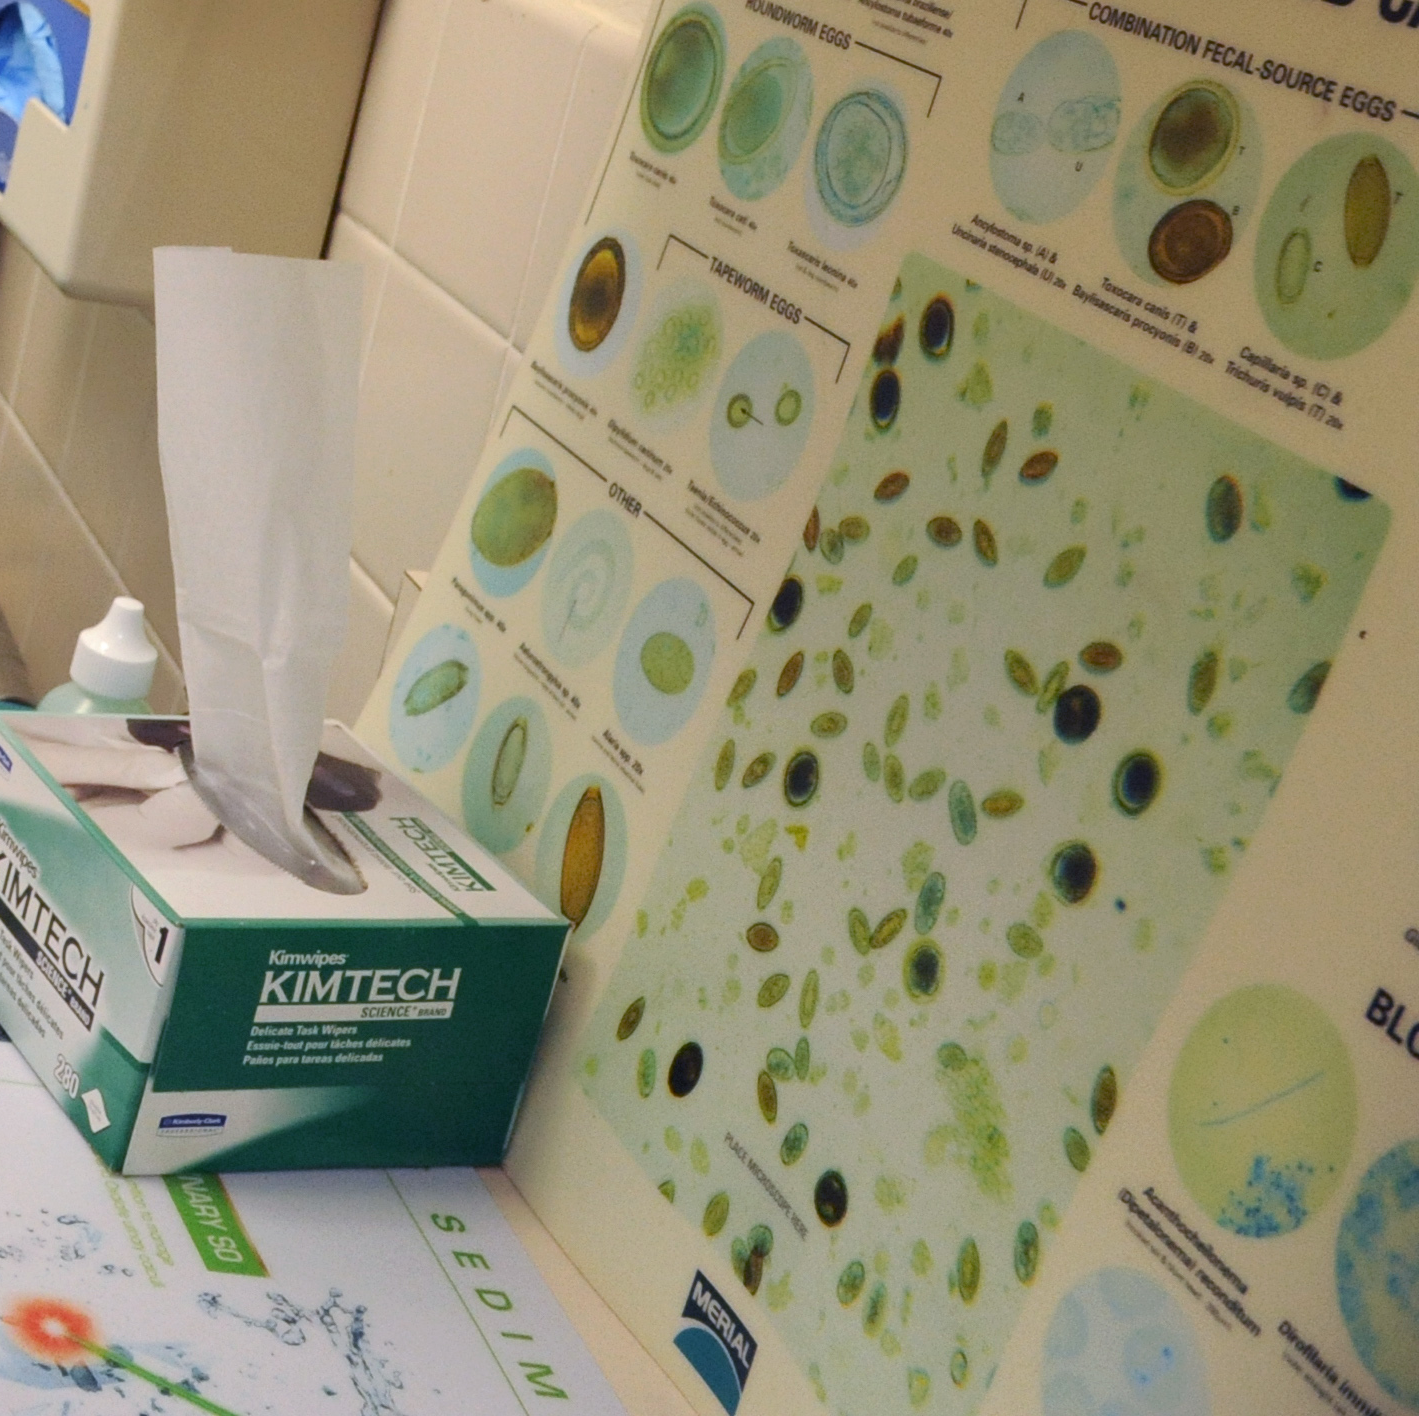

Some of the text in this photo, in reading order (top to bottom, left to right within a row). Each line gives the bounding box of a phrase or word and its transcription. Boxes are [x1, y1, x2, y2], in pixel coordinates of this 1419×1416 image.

[819, 24, 852, 50] EGGS
[1088, 1, 1398, 122] COMBINATION FECAL-SOURCE EGGS
[952, 222, 987, 250] Uncinaria
[988, 244, 1039, 276] stenocephala
[971, 214, 1021, 247] Ancylostoma
[1049, 251, 1058, 264] &
[708, 256, 770, 306] TAPEWORM
[769, 291, 803, 325] EGGS
[1101, 277, 1143, 307] Toxocara
[1144, 301, 1171, 320] canis
[1187, 320, 1198, 334] &
[1131, 317, 1181, 348] procyonis
[1181, 340, 1199, 356] (B)
[1225, 360, 1270, 393] Trichuris
[1273, 388, 1306, 412] vulpis
[1240, 346, 1291, 380] Capillaria
[1330, 391, 1343, 406] &
[608, 482, 643, 518] OTHER
[390, 817, 484, 893] KIMTECH
[13, 947, 35, 980] Wipers
[154, 926, 169, 965] 1
[269, 950, 348, 968] Kimwipes
[259, 967, 462, 1004] KIMTECH
[250, 1025, 358, 1037] Delicate Task Wipers
[360, 1005, 448, 1018] SCIENCE BRAND
[243, 1052, 384, 1067] Paños para tareas delicadas
[246, 1040, 304, 1051] Essuie-tout
[304, 1040, 328, 1052] pour
[330, 1038, 363, 1049] tâches
[53, 1053, 80, 1100] 280
[177, 1175, 228, 1231] NARY
[747, 1157, 792, 1218] MICROSCOPE
[692, 1280, 749, 1369] MERIAL
[1195, 1268, 1261, 1337] reconditum
[1277, 1319, 1339, 1385] Dirofilaria
